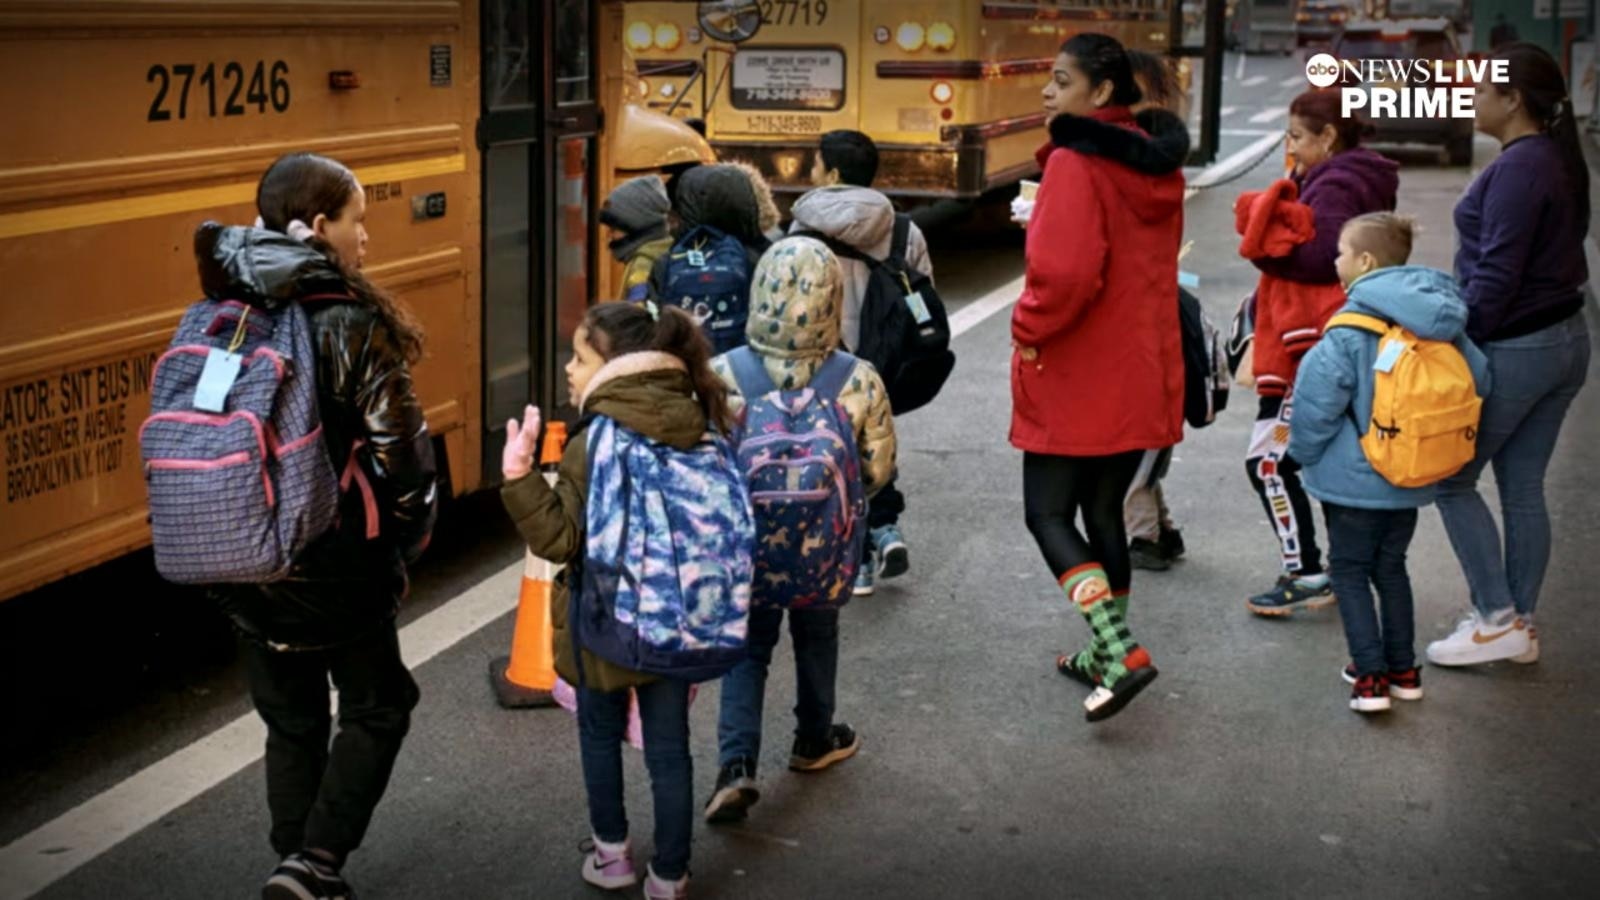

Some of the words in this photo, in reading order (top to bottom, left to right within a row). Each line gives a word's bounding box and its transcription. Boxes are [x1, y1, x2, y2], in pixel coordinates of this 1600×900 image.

[147, 59, 290, 122] 271246
[0, 380, 55, 430] ATOR:
[60, 368, 92, 415] SNT
[97, 359, 130, 405] BUS
[22, 416, 81, 462] SNEDIKER
[84, 403, 127, 443] AVENUE
[7, 455, 71, 504] BROOKLYN
[95, 439, 124, 475] 11207
